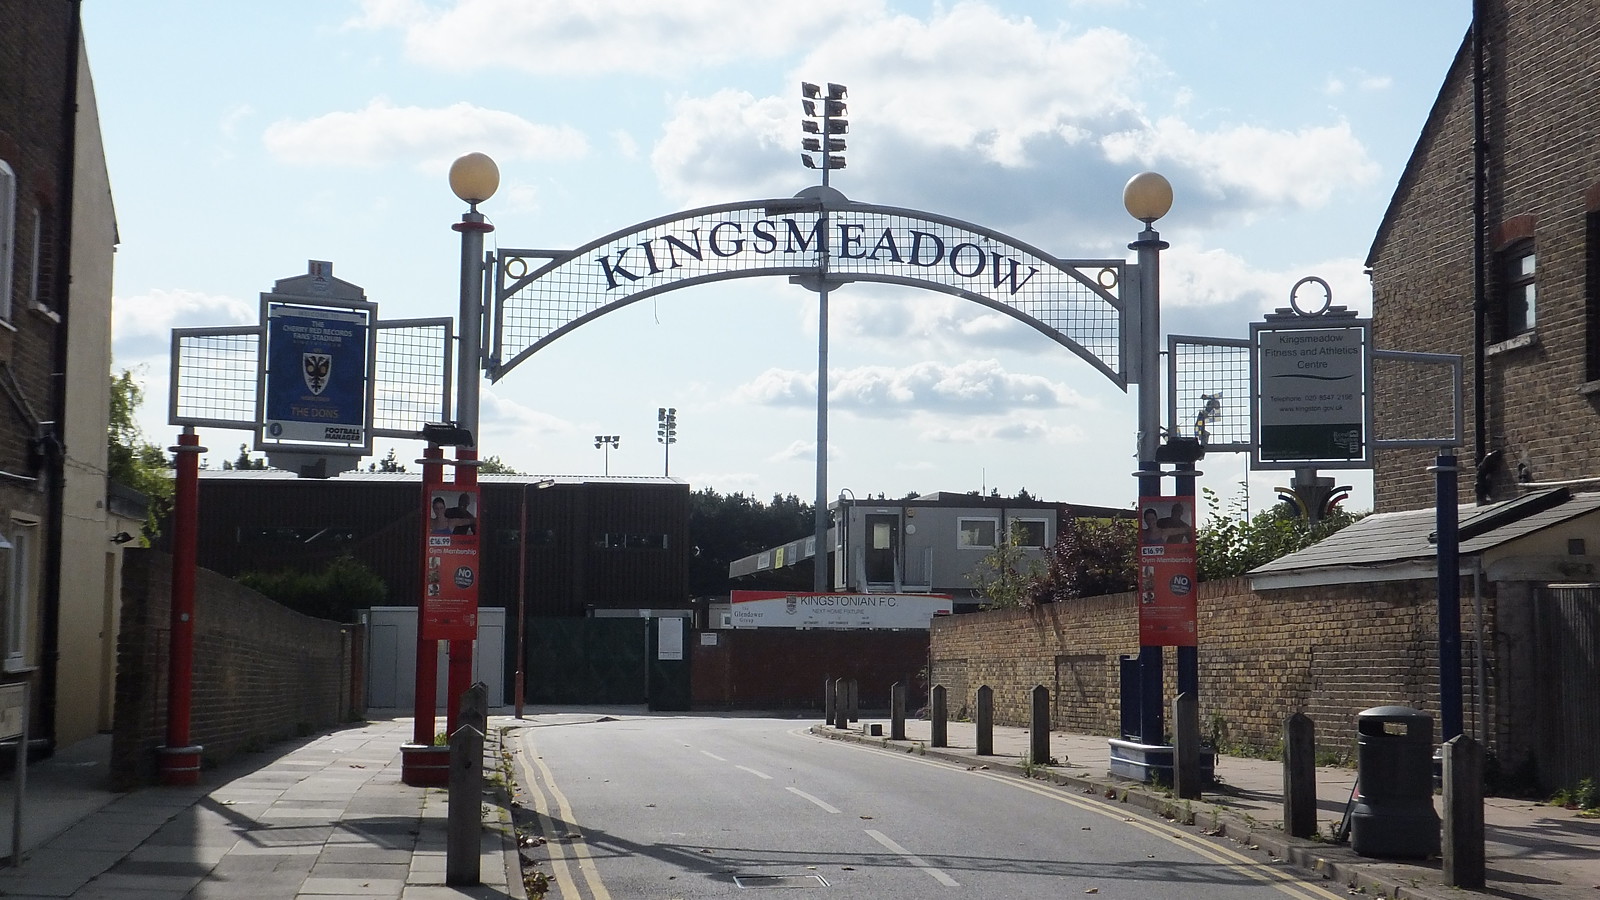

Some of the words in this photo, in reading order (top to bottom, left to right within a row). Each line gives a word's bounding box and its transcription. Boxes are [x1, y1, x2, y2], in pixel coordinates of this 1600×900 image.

[594, 218, 1040, 296] KINGSMEADOW
[282, 325, 308, 333] CHERRY
[323, 328, 353, 337] RECORDS
[312, 334, 342, 342] STADIUM
[1279, 334, 1344, 345] Kingsmeadow
[1265, 348, 1298, 357] Fitness
[1299, 347, 1317, 356] and
[1318, 345, 1359, 355] Athletics
[1297, 360, 1328, 369] Centre
[1304, 394, 1317, 402] 020
[291, 406, 310, 417] THE
[311, 408, 339, 418] DONS
[1279, 405, 1343, 413] www.kingston.gov.uk
[325, 427, 360, 435] FOOTBALL
[325, 433, 360, 441] MANAGER
[430, 537, 450, 545] £16.99
[429, 547, 442, 556] Gym
[443, 547, 477, 556] Membership
[1142, 547, 1164, 555] £16.99
[1156, 556, 1193, 564] Membership
[458, 568, 471, 577] NO
[1174, 576, 1188, 585] NO
[800, 596, 877, 606] KINGSTONIAN
[879, 597, 899, 607] F.C.
